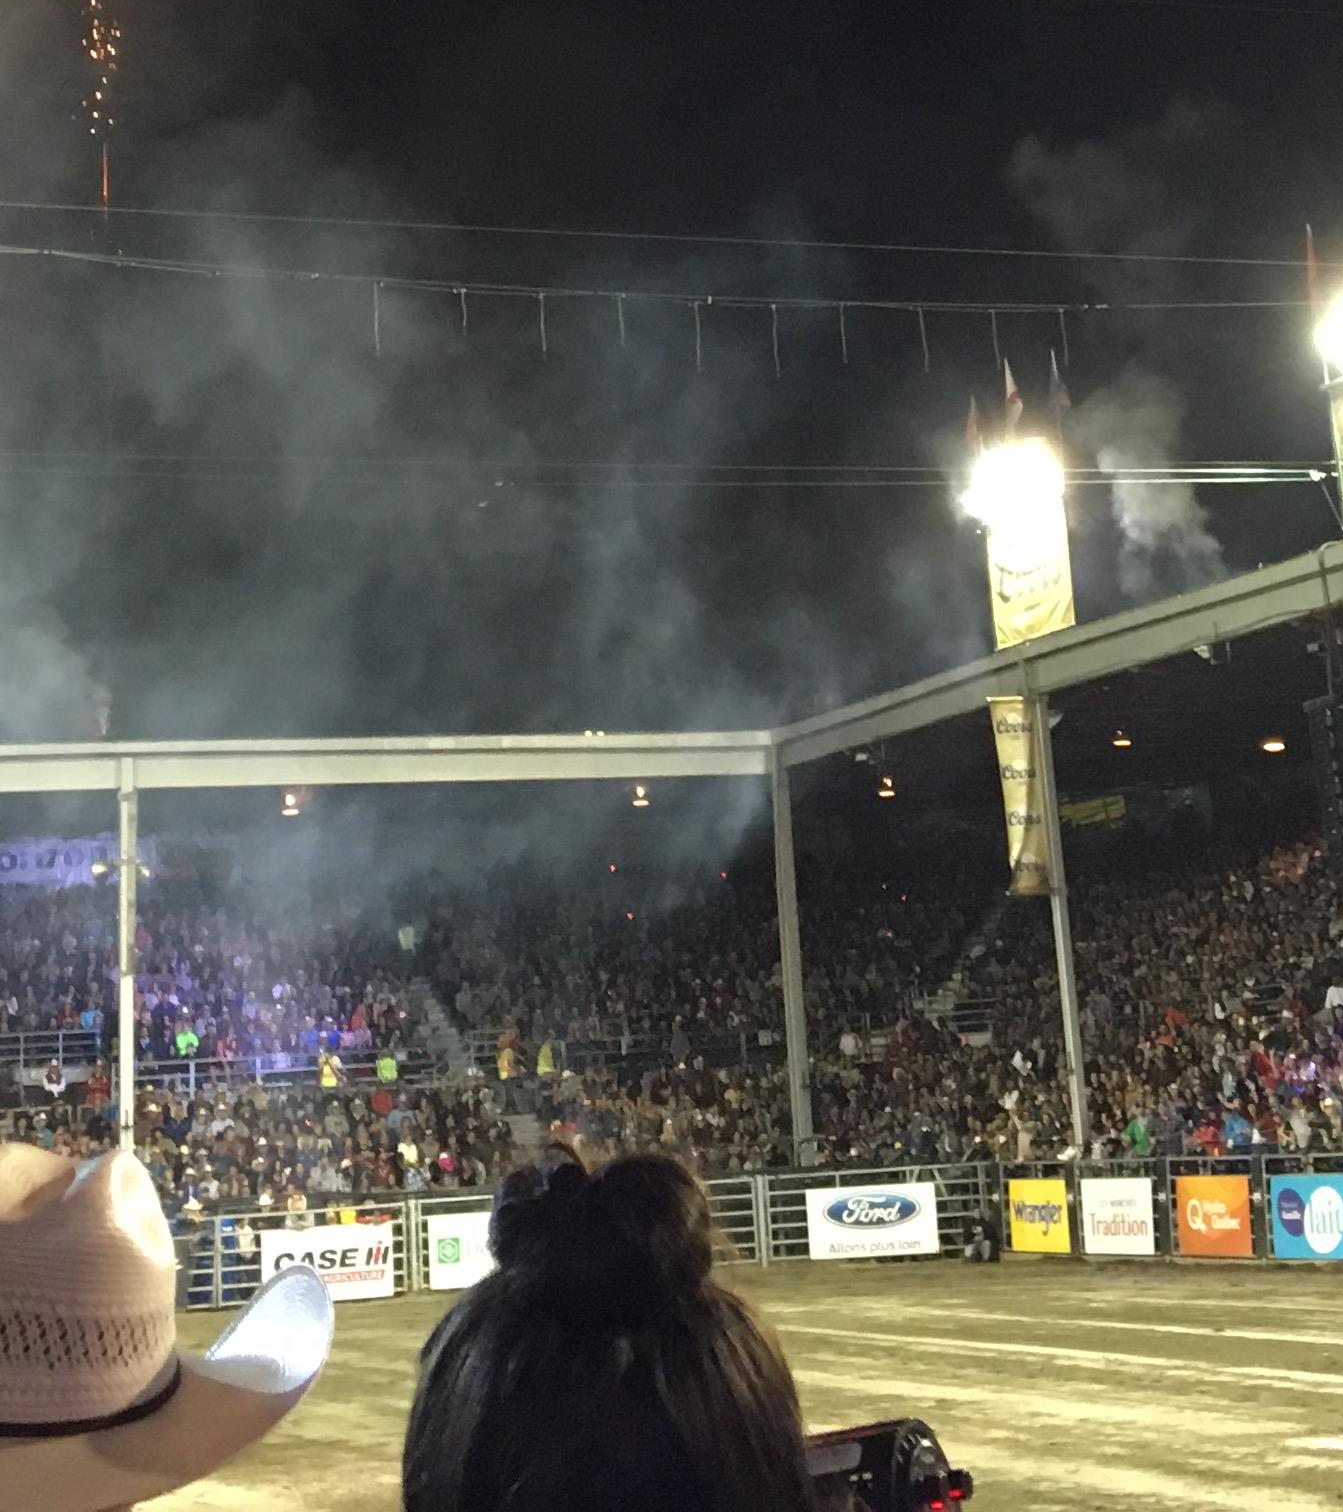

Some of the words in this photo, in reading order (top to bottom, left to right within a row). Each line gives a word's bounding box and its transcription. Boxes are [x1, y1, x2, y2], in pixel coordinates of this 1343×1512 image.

[842, 1196, 900, 1223] Ford
[1012, 1200, 1062, 1236] Wrangler
[1309, 1200, 1343, 1235] lait
[1089, 1212, 1148, 1236] Tradition
[274, 1247, 359, 1271] CASE
[870, 1241, 896, 1253] plus
